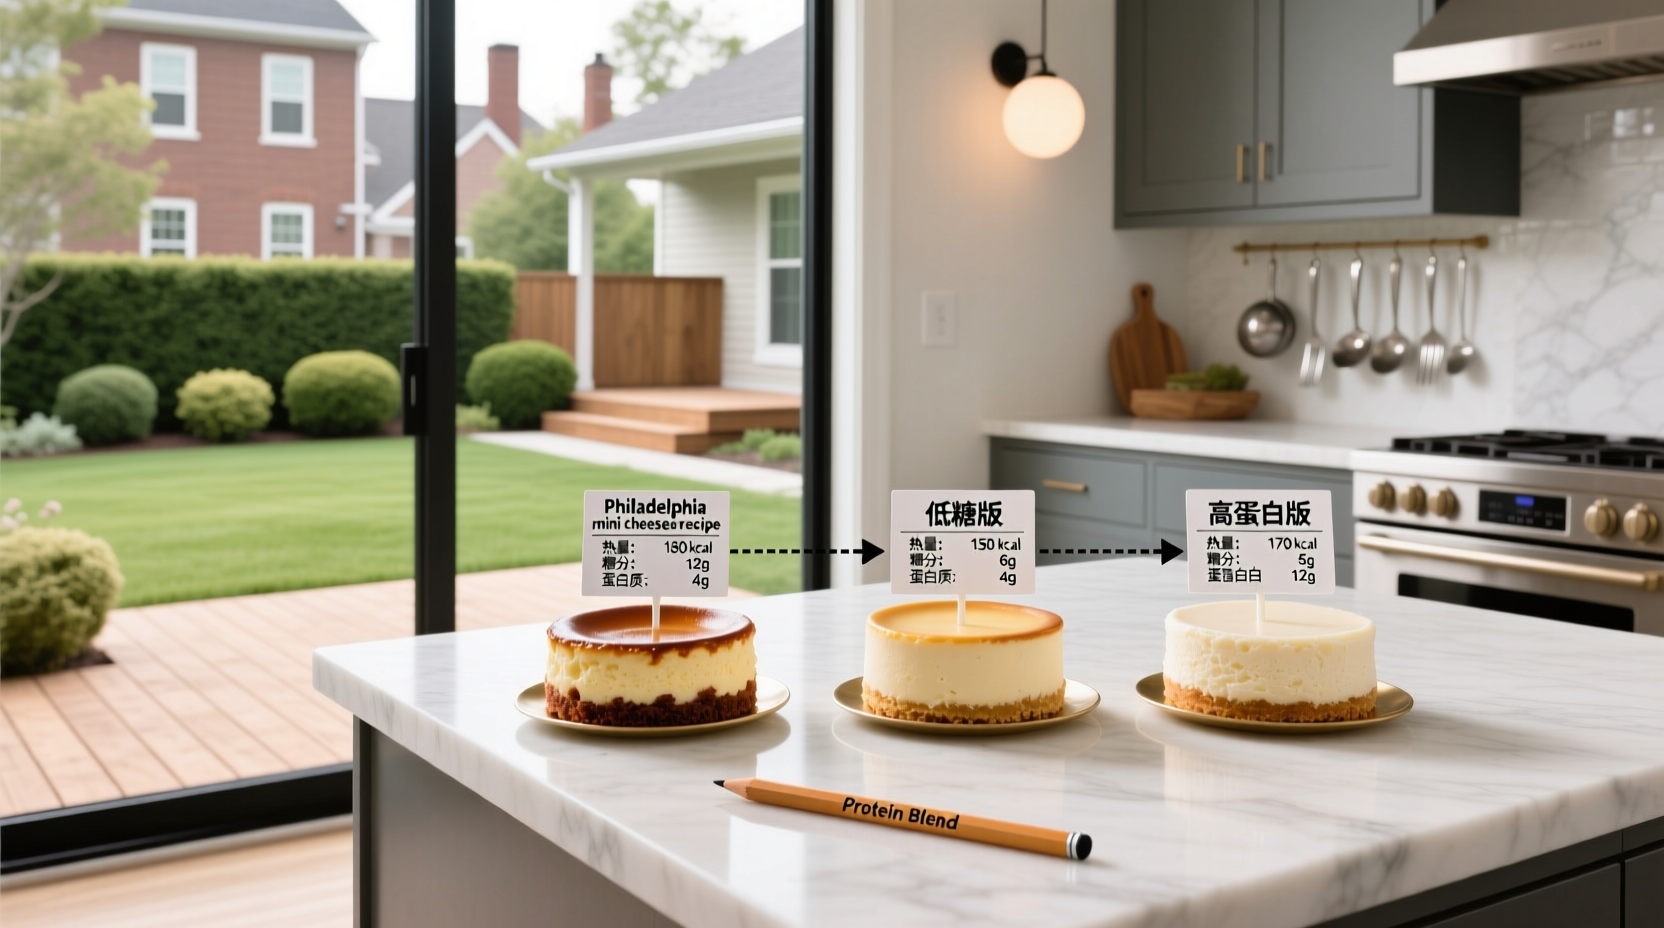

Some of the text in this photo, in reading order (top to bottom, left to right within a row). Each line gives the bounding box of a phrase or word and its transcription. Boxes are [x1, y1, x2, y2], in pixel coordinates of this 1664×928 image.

[604, 497, 707, 519] Philadelphia
[925, 500, 1004, 528] 低糖版
[1208, 500, 1311, 527] 高蛋白版
[592, 516, 621, 530] mini
[679, 516, 721, 534] recipe
[970, 537, 995, 551] 150
[997, 537, 1021, 551] kcal
[1268, 537, 1292, 550] 170
[686, 558, 710, 573] 12g
[999, 554, 1017, 570] 6g
[1298, 553, 1315, 569] 5g
[691, 573, 710, 590] 4g
[999, 571, 1017, 586] 4g
[1291, 569, 1316, 585] 12g
[842, 797, 960, 830] Protein Blend
